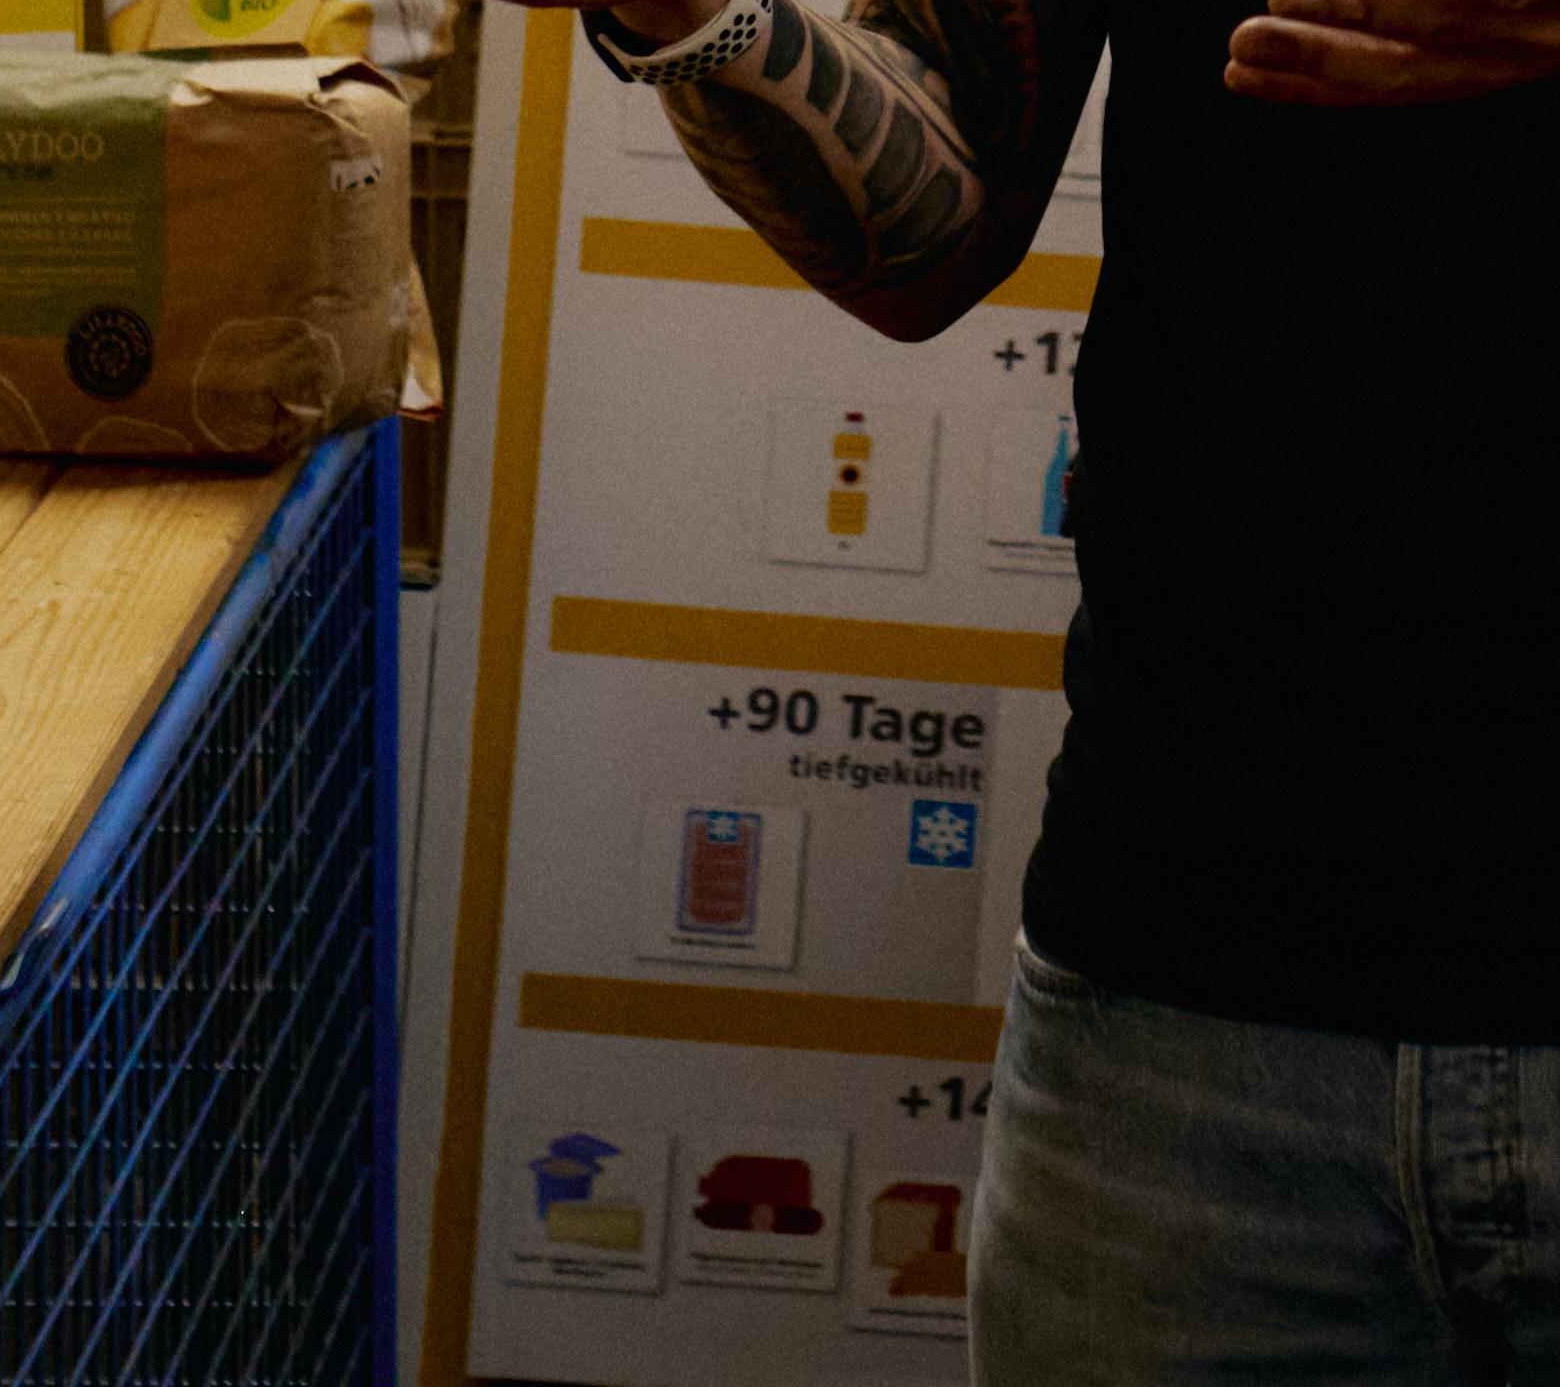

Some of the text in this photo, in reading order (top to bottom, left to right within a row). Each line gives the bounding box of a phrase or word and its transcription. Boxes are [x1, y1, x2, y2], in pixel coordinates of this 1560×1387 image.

[993, 331, 1084, 376] +1
[706, 688, 985, 758] +90 Tage
[790, 754, 982, 792] tiefgekühlt
